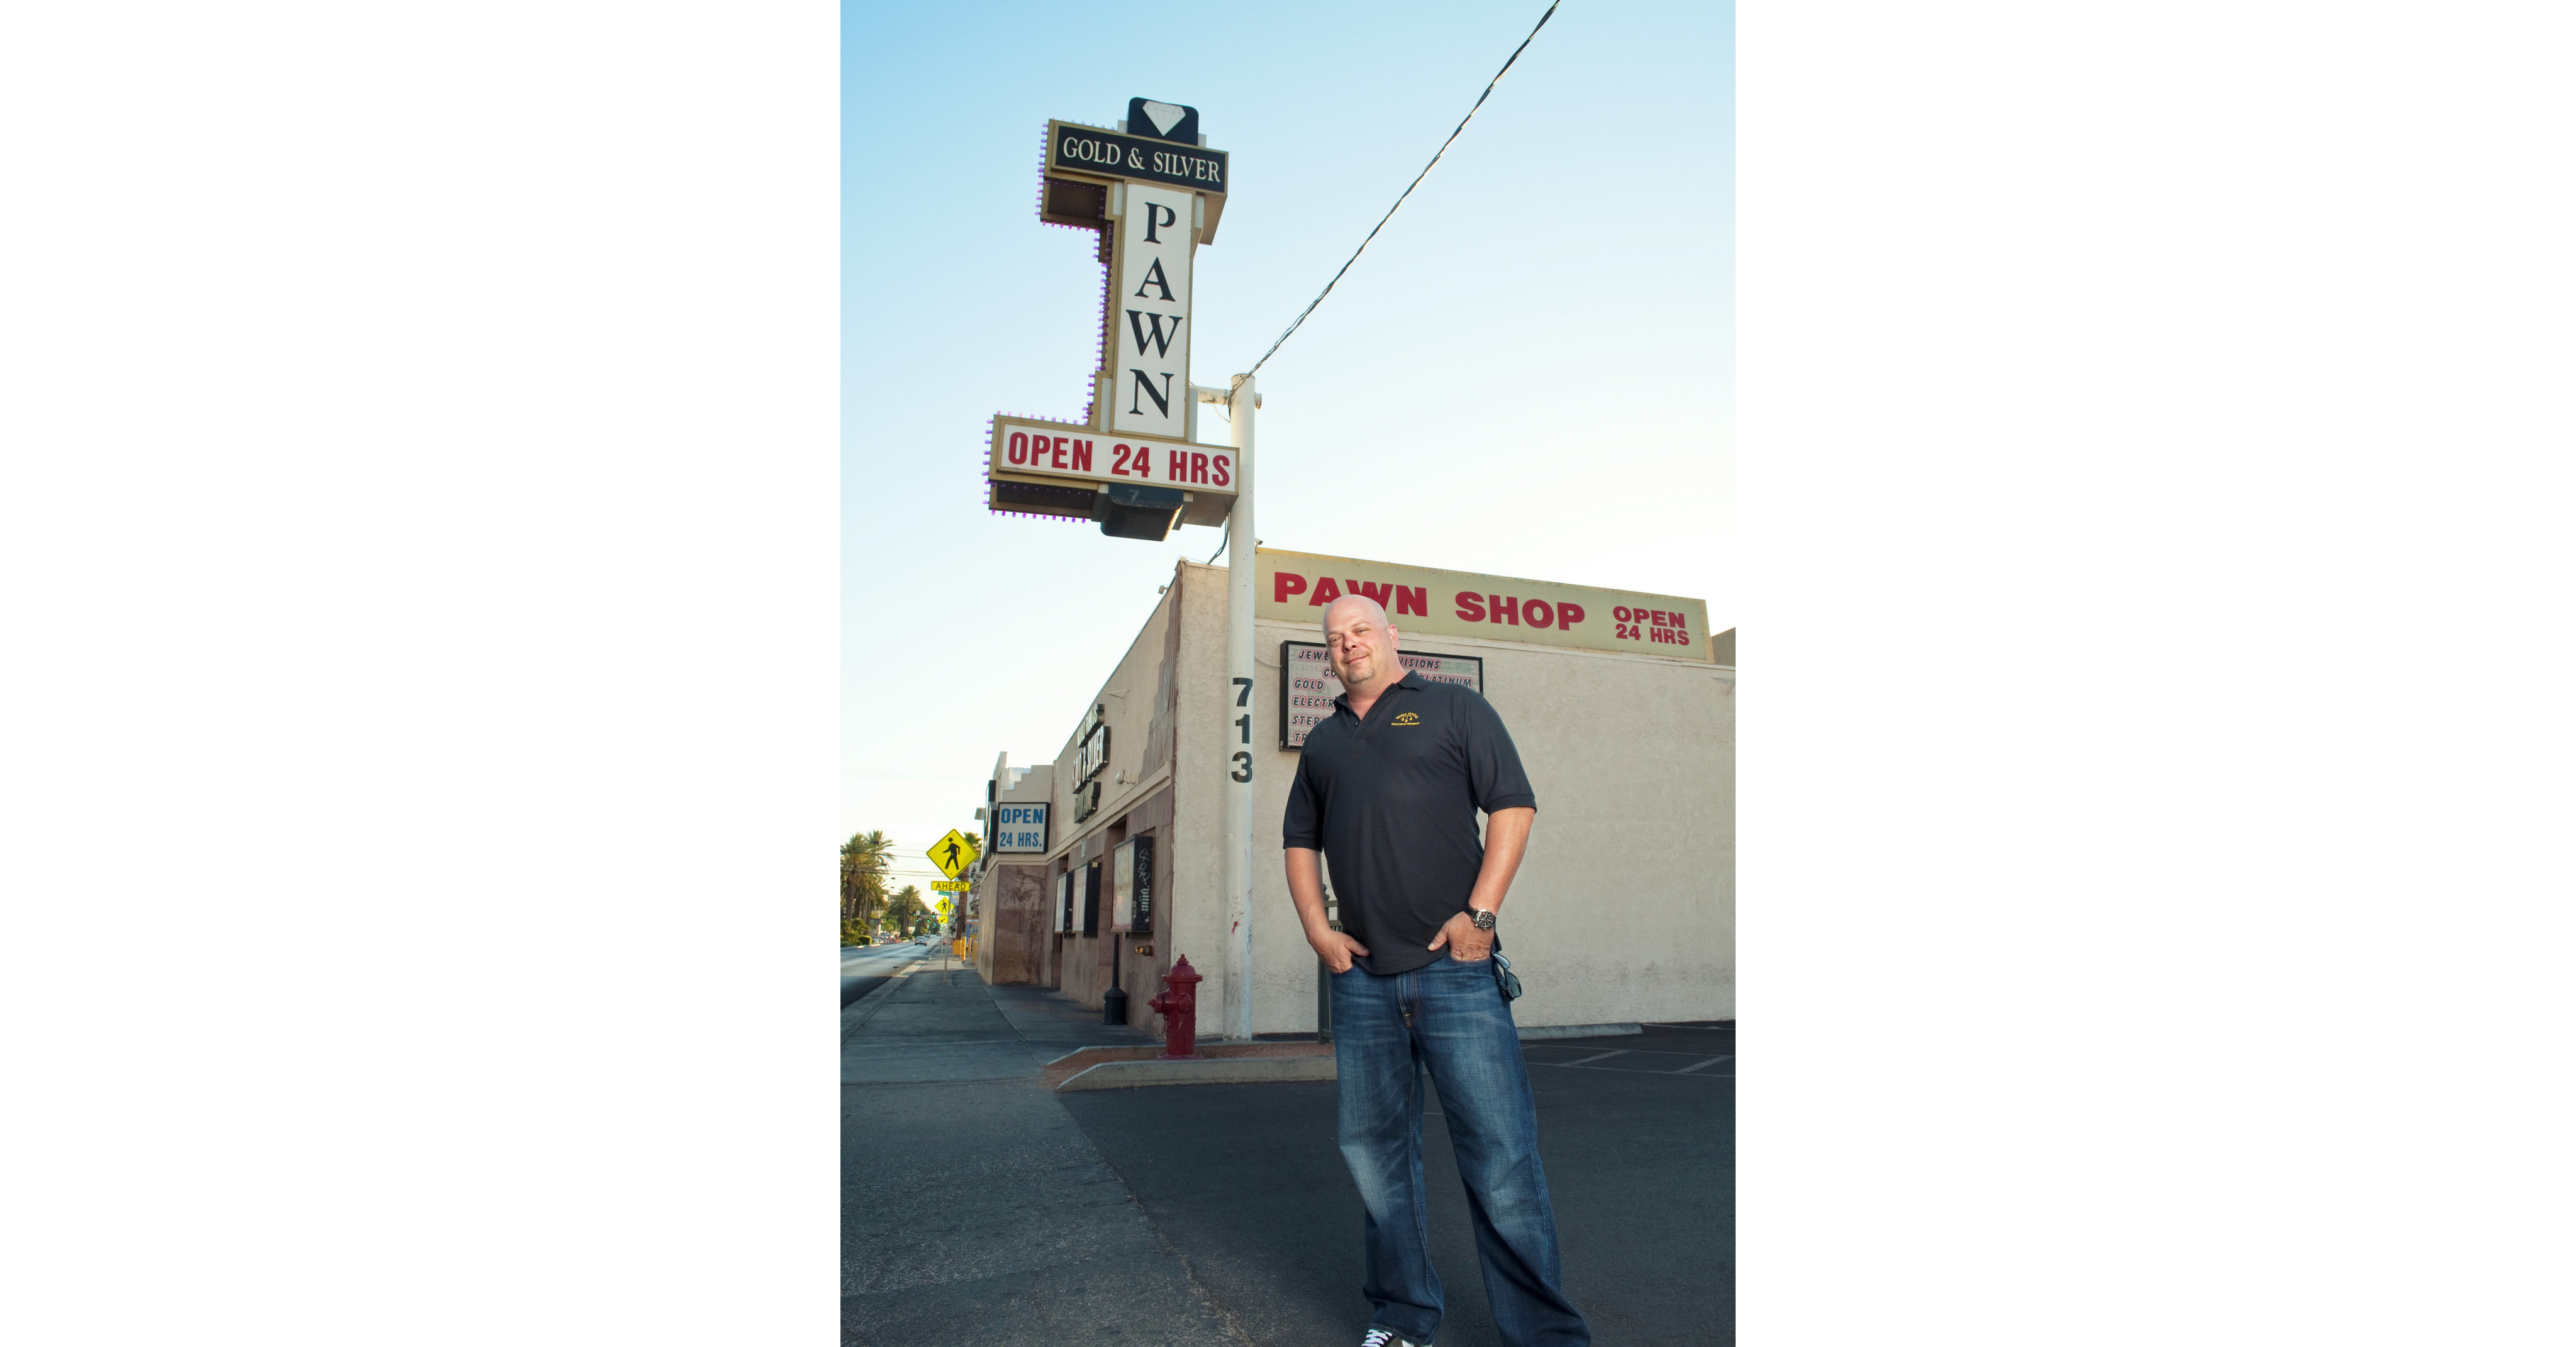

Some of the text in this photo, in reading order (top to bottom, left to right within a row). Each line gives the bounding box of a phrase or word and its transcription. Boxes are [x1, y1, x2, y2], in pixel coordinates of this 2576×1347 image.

[1063, 136, 1221, 182] GOLD & SILVER
[1125, 201, 1183, 419] PAWN
[1008, 431, 1230, 487] OPEN 24 HRS
[1274, 571, 1585, 631] PAWN SHOP
[1612, 606, 1687, 629] OPEN
[1615, 623, 1690, 646] 24 HRS
[1297, 650, 1441, 670] JEWE VISIONS
[1293, 679, 1325, 690] GOLD
[1293, 696, 1335, 709] ELECTR
[1231, 677, 1253, 783] 713
[1001, 808, 1044, 824] OPEN
[999, 831, 1042, 847] 24 HRS.
[935, 882, 966, 890] AHEAD
